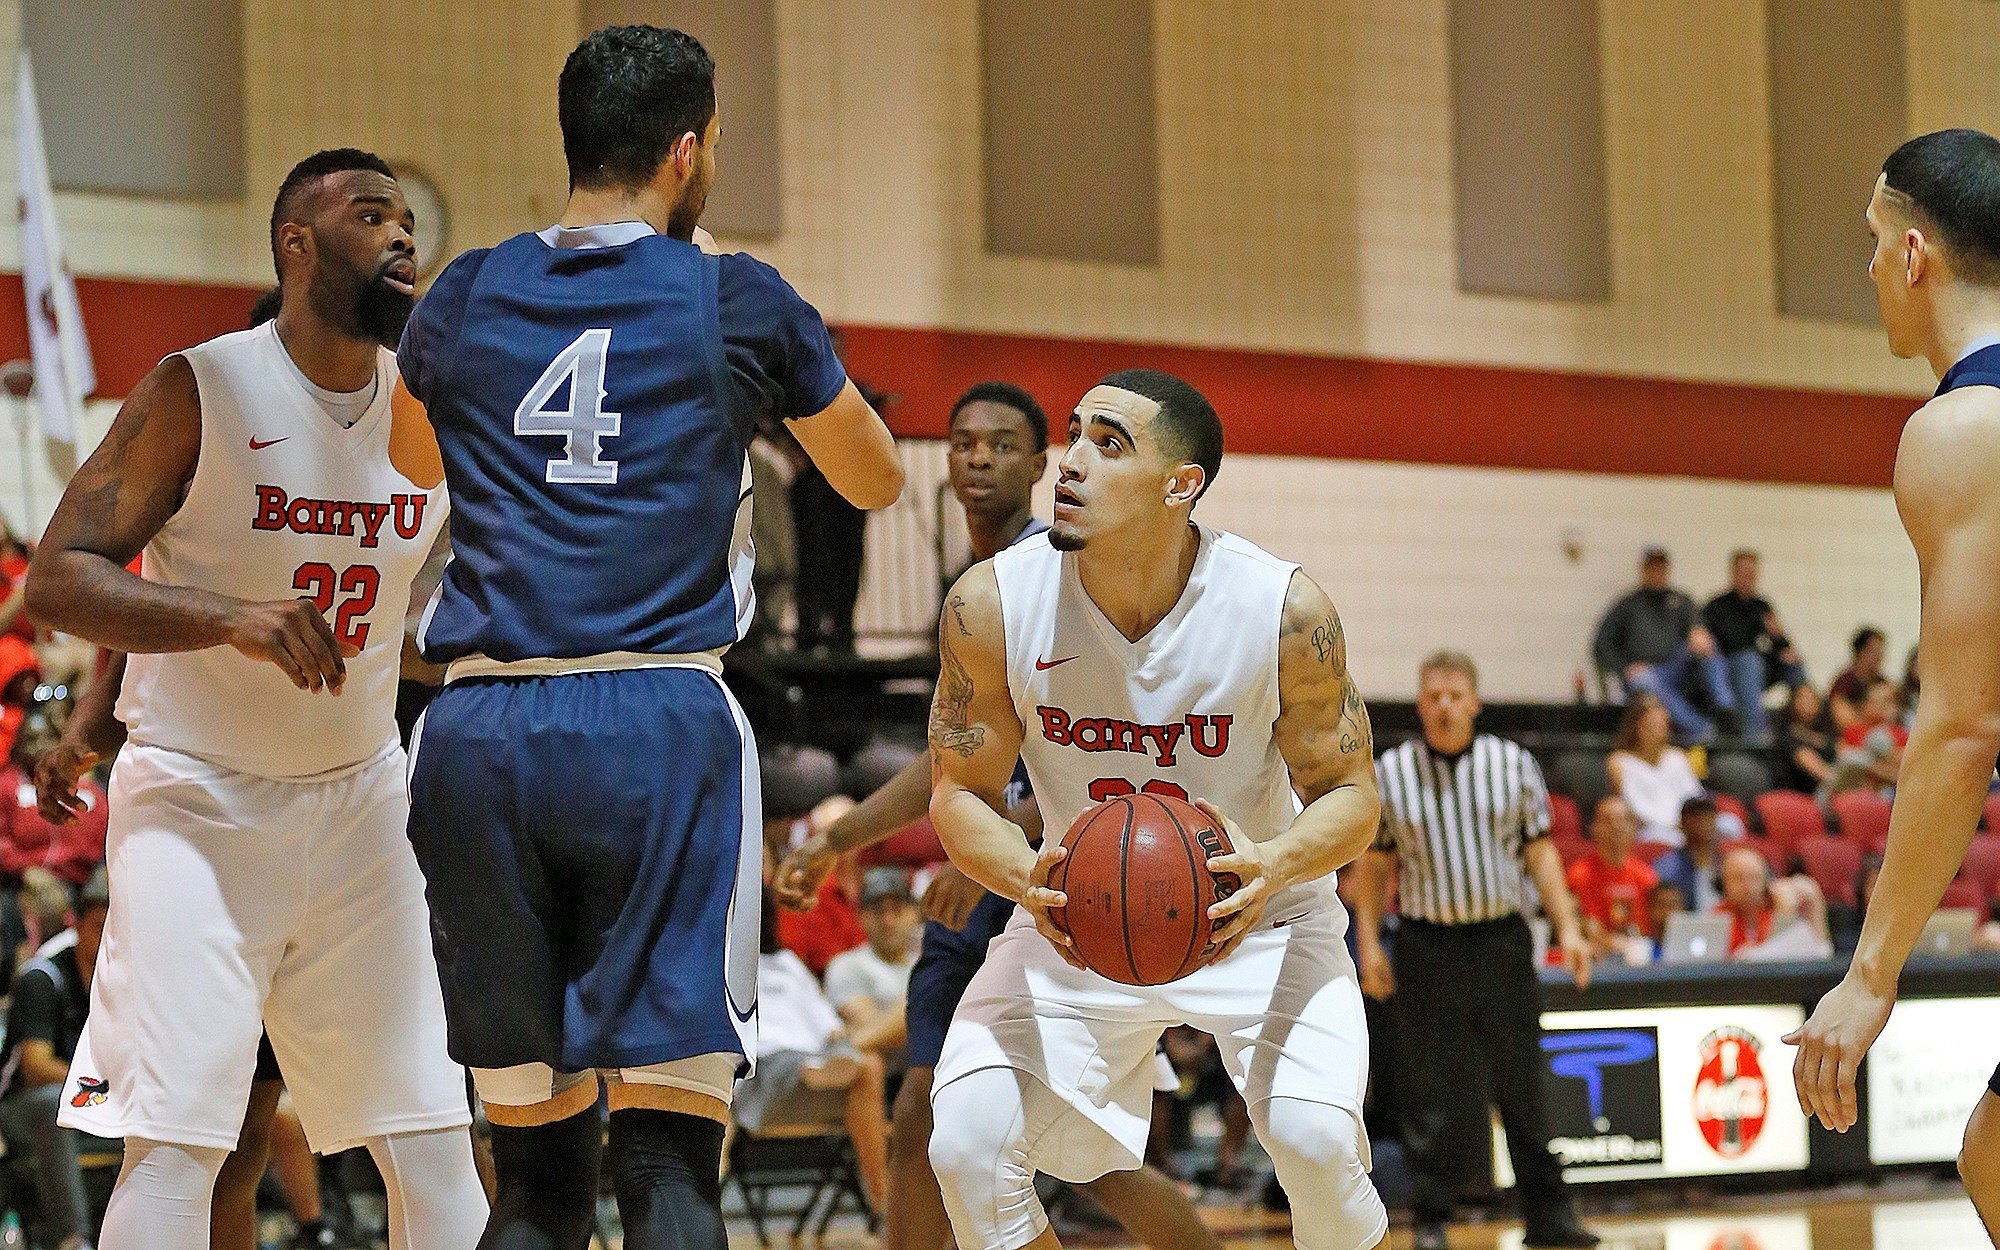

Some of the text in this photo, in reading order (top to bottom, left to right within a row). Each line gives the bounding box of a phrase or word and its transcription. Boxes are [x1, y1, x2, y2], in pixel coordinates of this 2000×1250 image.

[513, 327, 622, 484] 4
[252, 484, 427, 548] Barry U
[1036, 705, 1233, 767] Barry U
